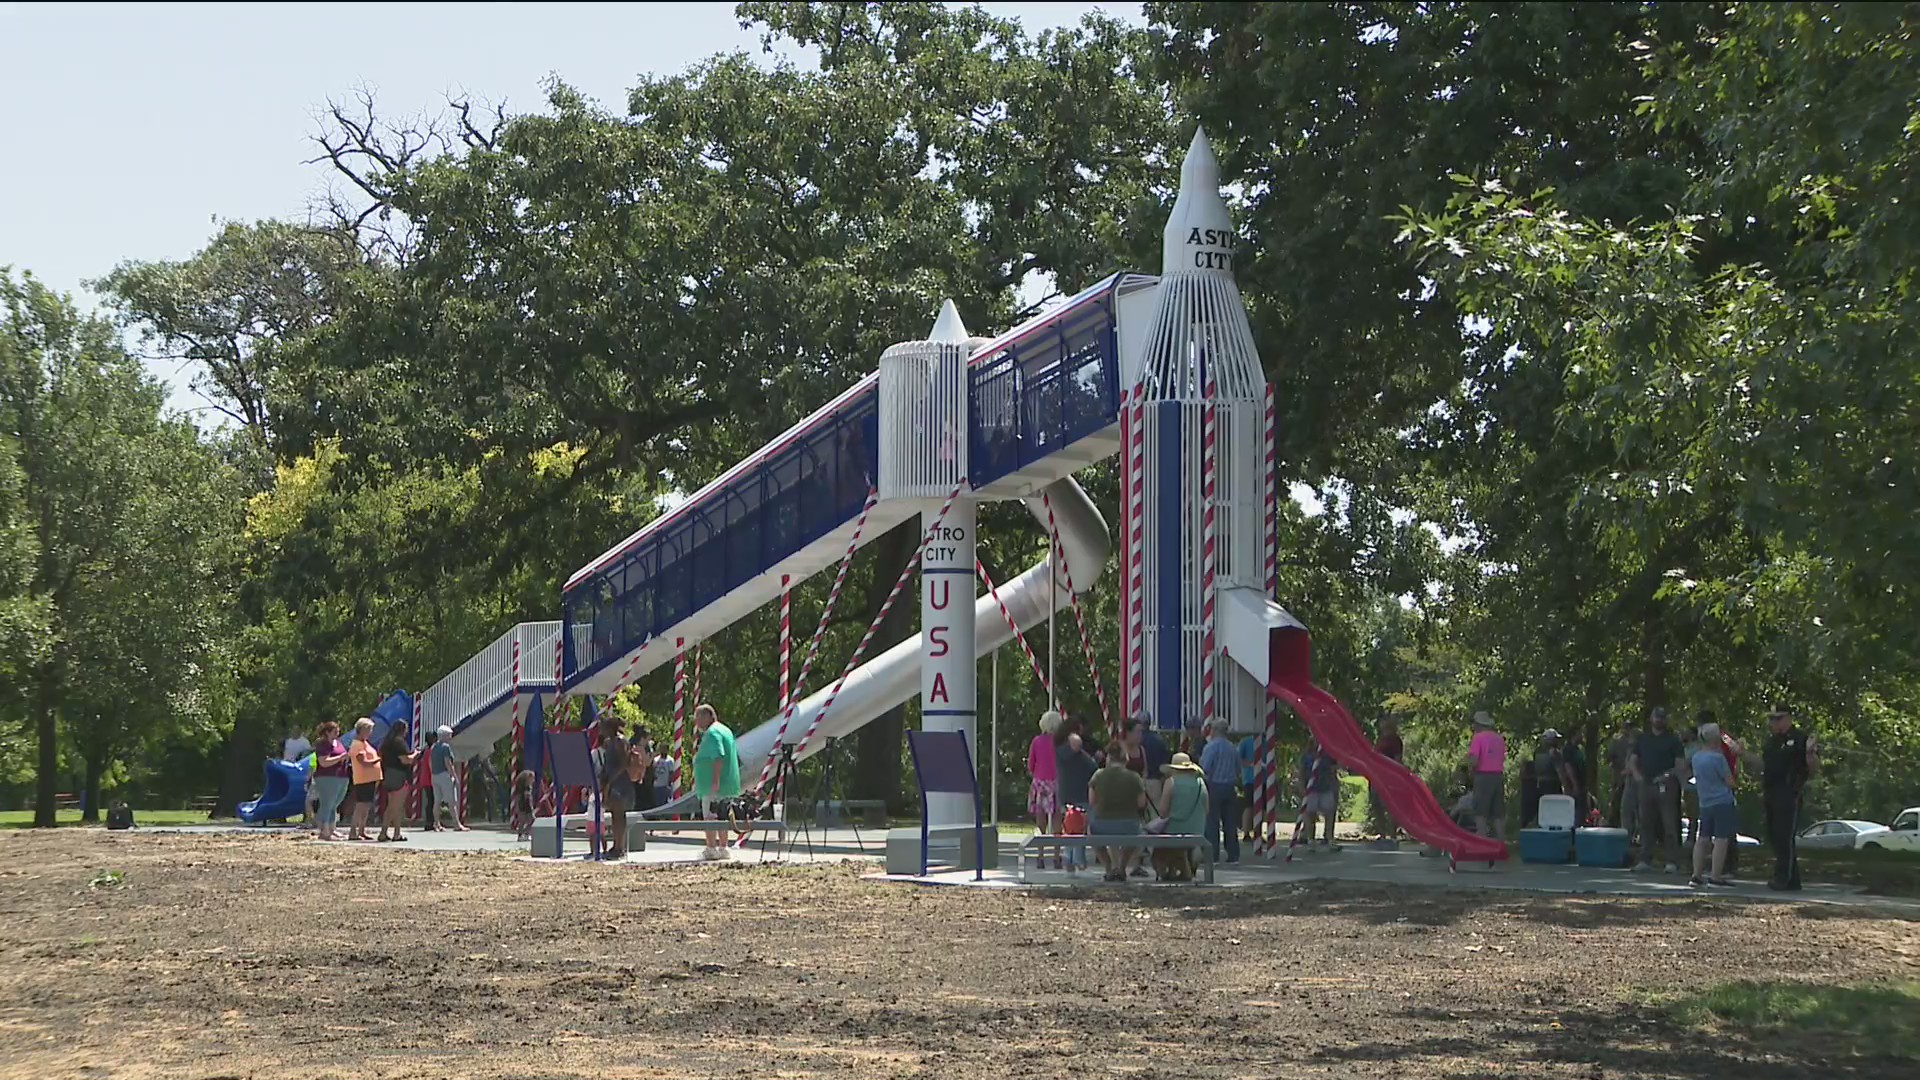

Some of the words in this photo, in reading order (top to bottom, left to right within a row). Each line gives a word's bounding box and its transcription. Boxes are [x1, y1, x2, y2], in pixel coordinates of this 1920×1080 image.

[1186, 227, 1233, 249] AST
[926, 547, 956, 561] CITY
[930, 580, 949, 703] USA
